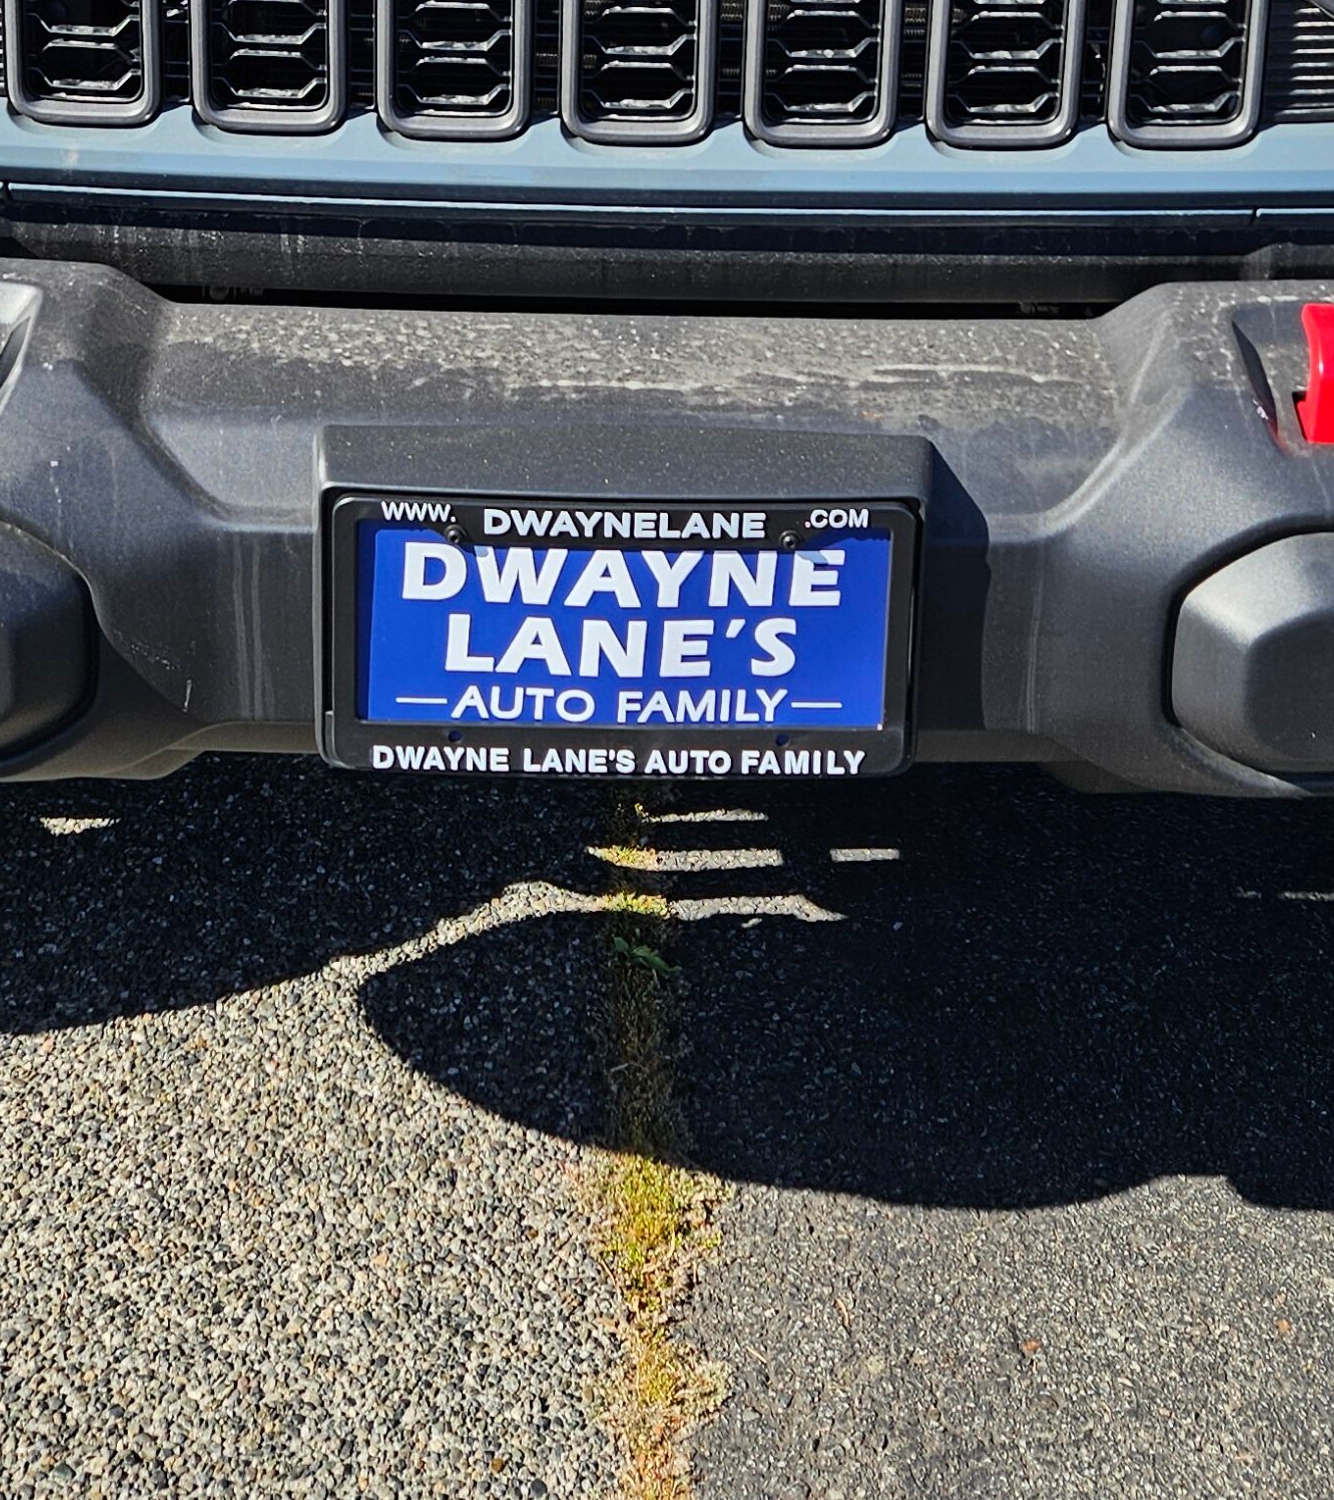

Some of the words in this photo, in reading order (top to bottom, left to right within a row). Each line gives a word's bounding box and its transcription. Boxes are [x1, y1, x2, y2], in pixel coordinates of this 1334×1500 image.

[482, 508, 766, 540] DWAYNELANE
[803, 507, 869, 530] .COM
[402, 541, 847, 609] DWAYNE
[445, 612, 798, 679] LANE'S
[451, 684, 596, 723] AUTO
[616, 688, 788, 724] FAMILY
[372, 745, 509, 772] DWAYNE
[523, 747, 636, 774] LANE'S
[645, 748, 732, 775] AUTO
[740, 750, 865, 777] FAMILY
